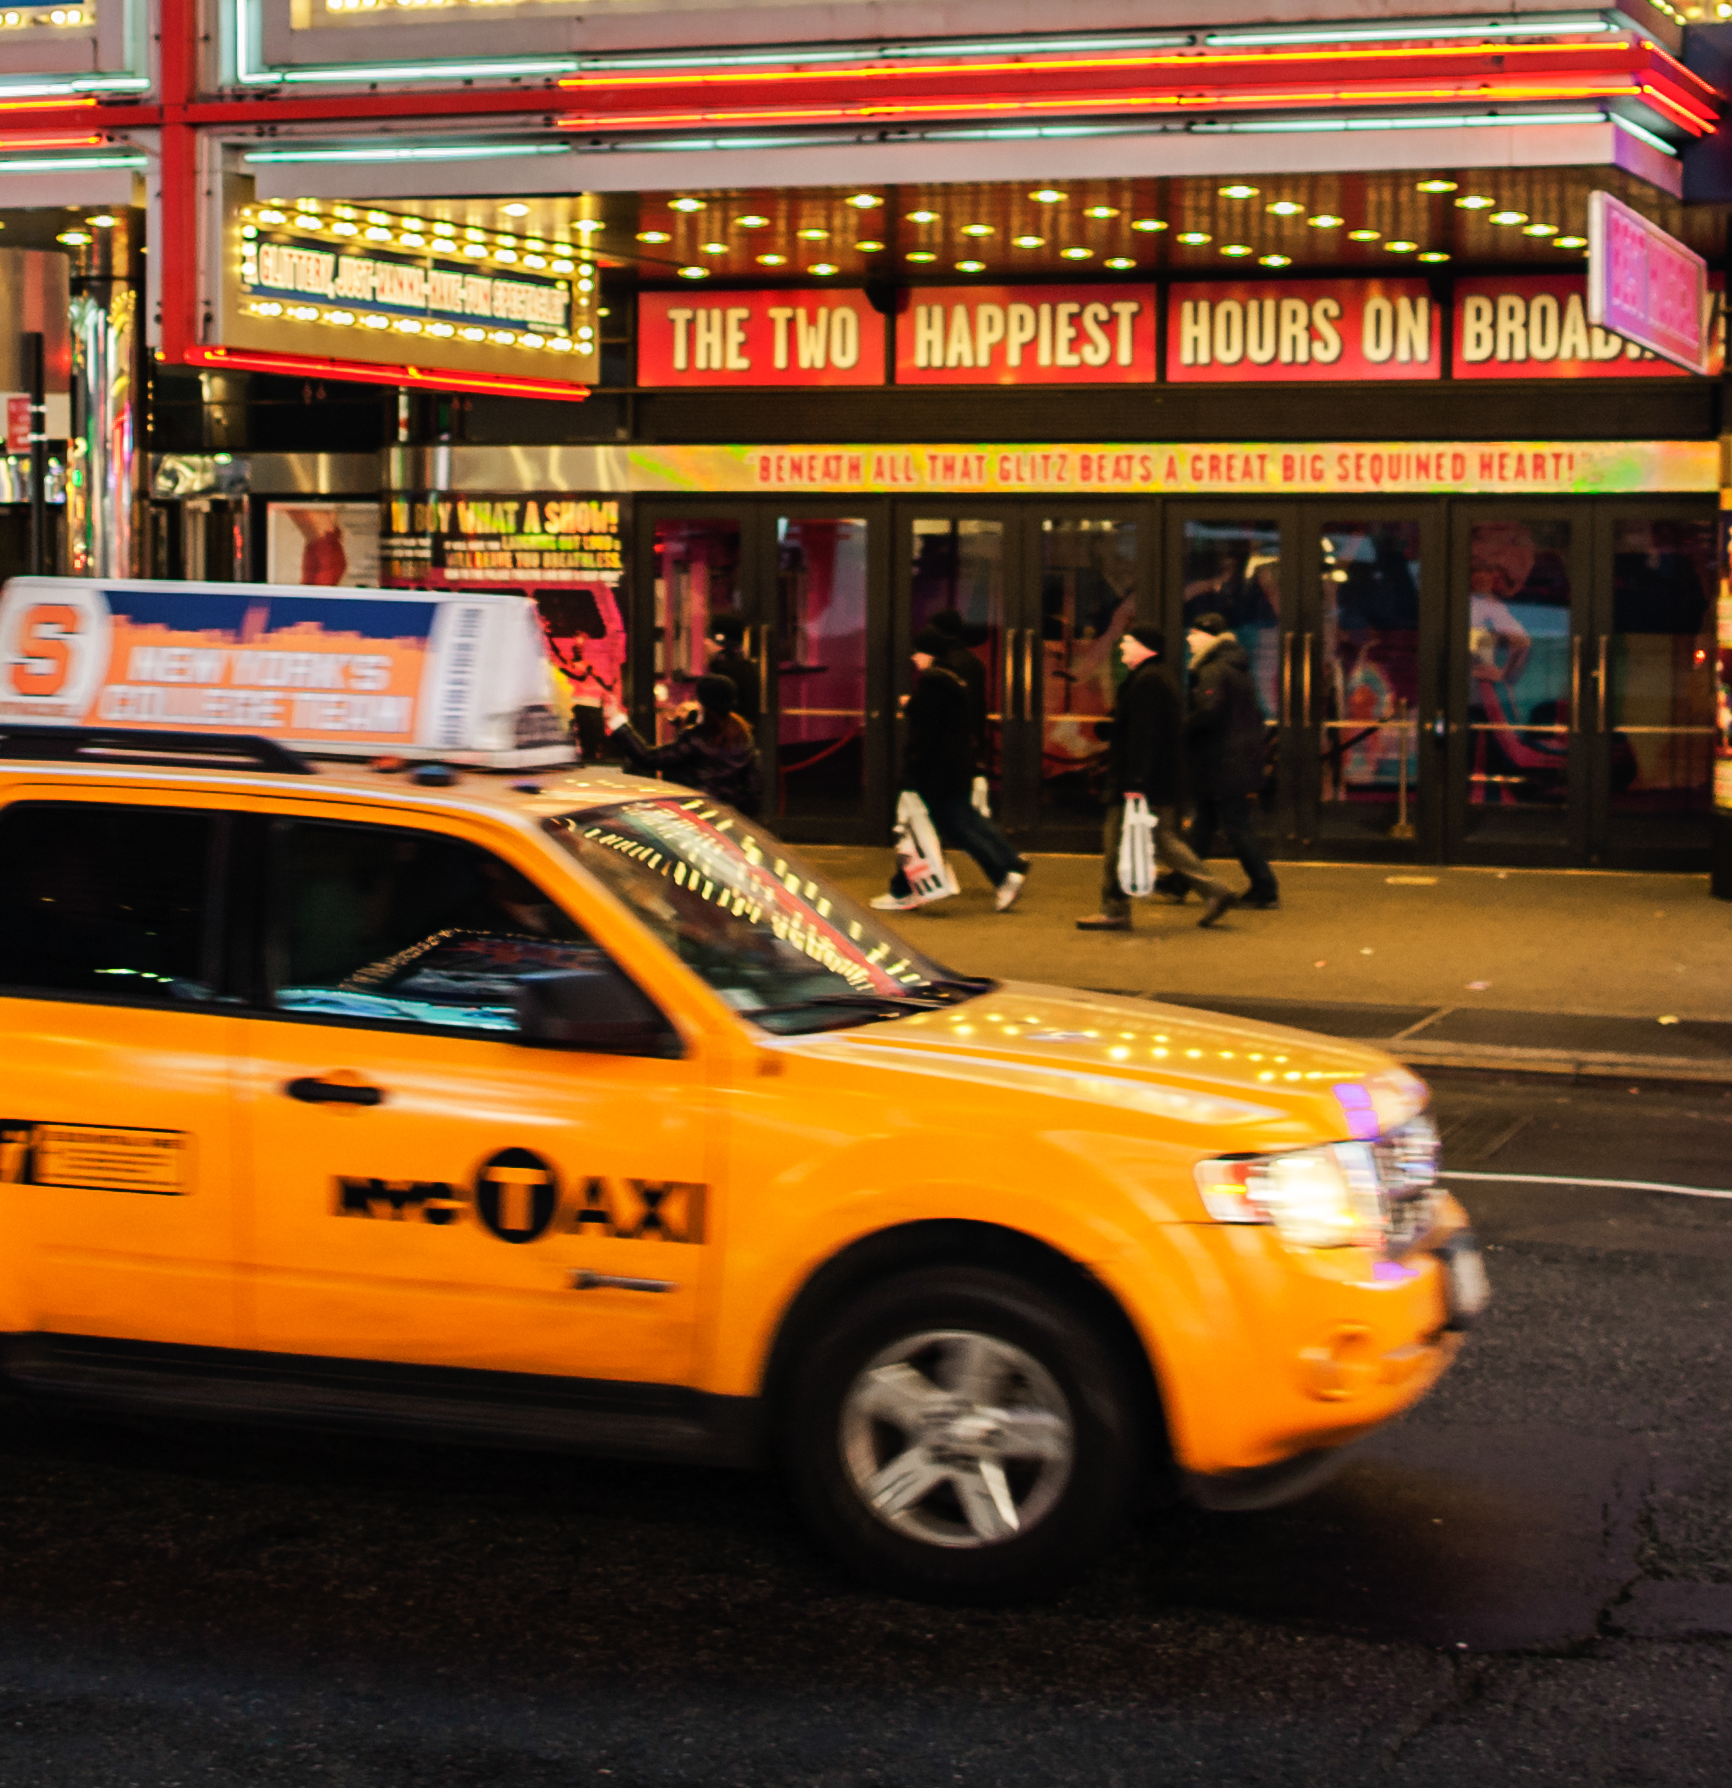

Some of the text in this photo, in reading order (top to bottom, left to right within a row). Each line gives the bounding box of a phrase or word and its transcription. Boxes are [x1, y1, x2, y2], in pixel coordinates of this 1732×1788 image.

[666, 296, 1433, 372] THE TWO HAPPIEST HOURS ON
[757, 452, 1576, 485] BENEATH ALL THAT GLITZ BEATS A GREAT BIG SEQUINED HEART!
[456, 500, 520, 534] WHAT
[523, 500, 542, 534] A
[543, 500, 619, 534] SHOW!
[126, 646, 226, 684] NEW
[95, 683, 414, 735] COLLEGE TEAM
[331, 1146, 709, 1245] NYC TAXI
